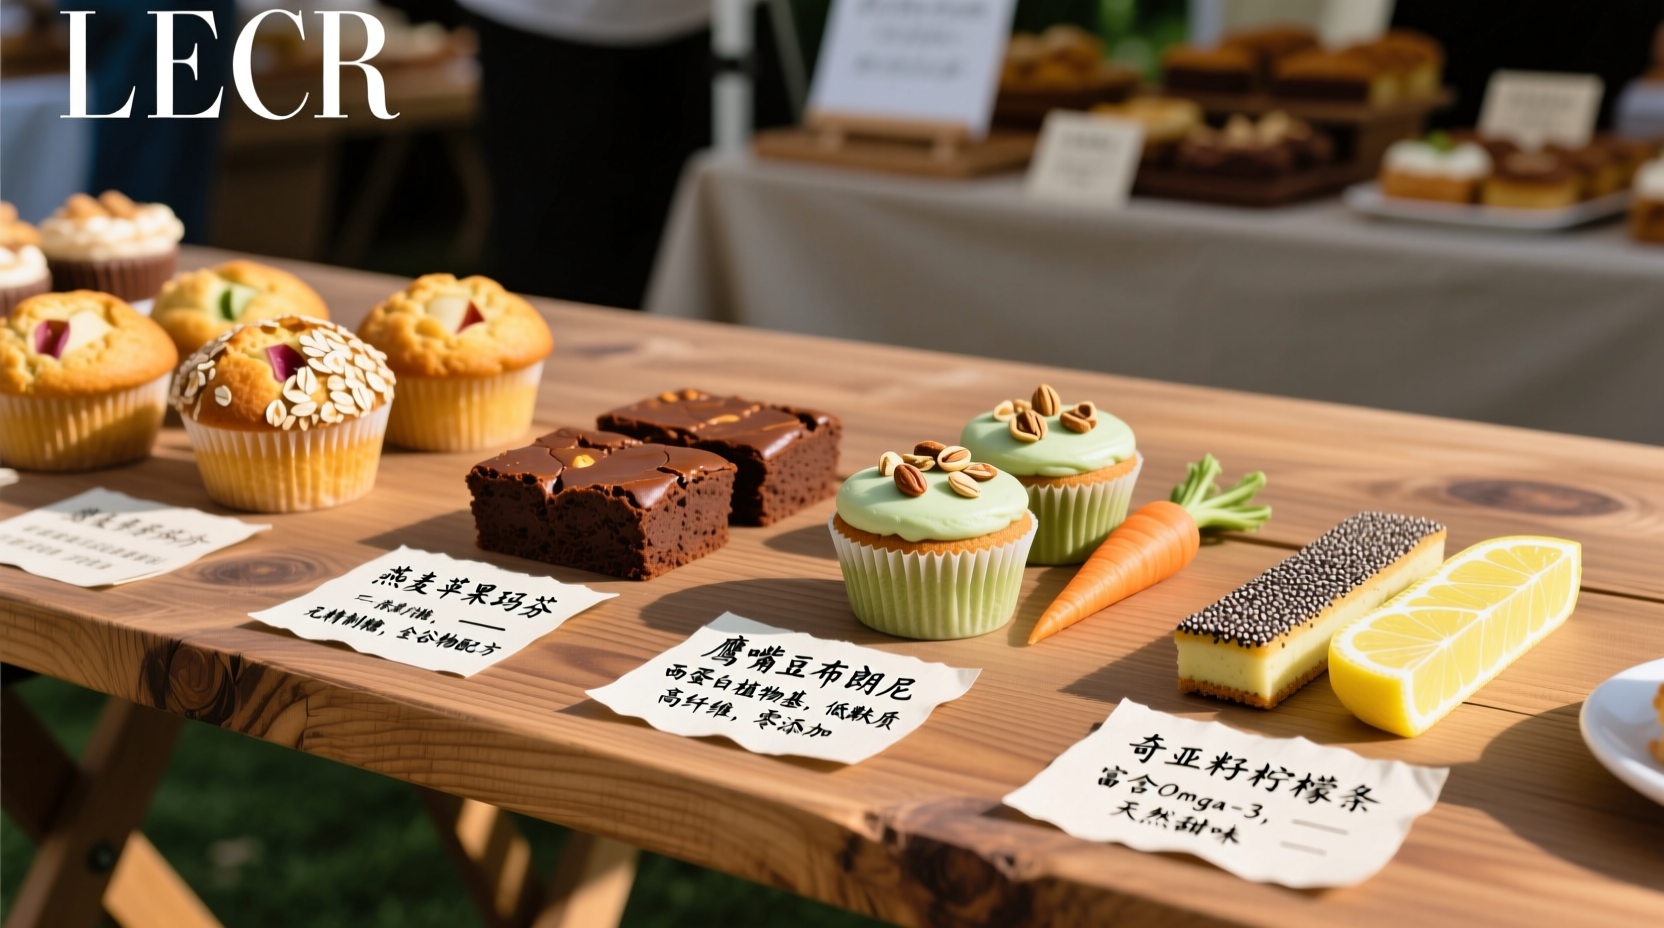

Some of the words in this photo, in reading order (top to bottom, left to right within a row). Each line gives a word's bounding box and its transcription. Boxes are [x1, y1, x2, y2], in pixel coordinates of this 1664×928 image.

[701, 636, 915, 701] 鹰嘴豆布朗尼
[1129, 734, 1380, 812] 奇亚籽柠檬条
[1113, 801, 1240, 845] 天然甜味
